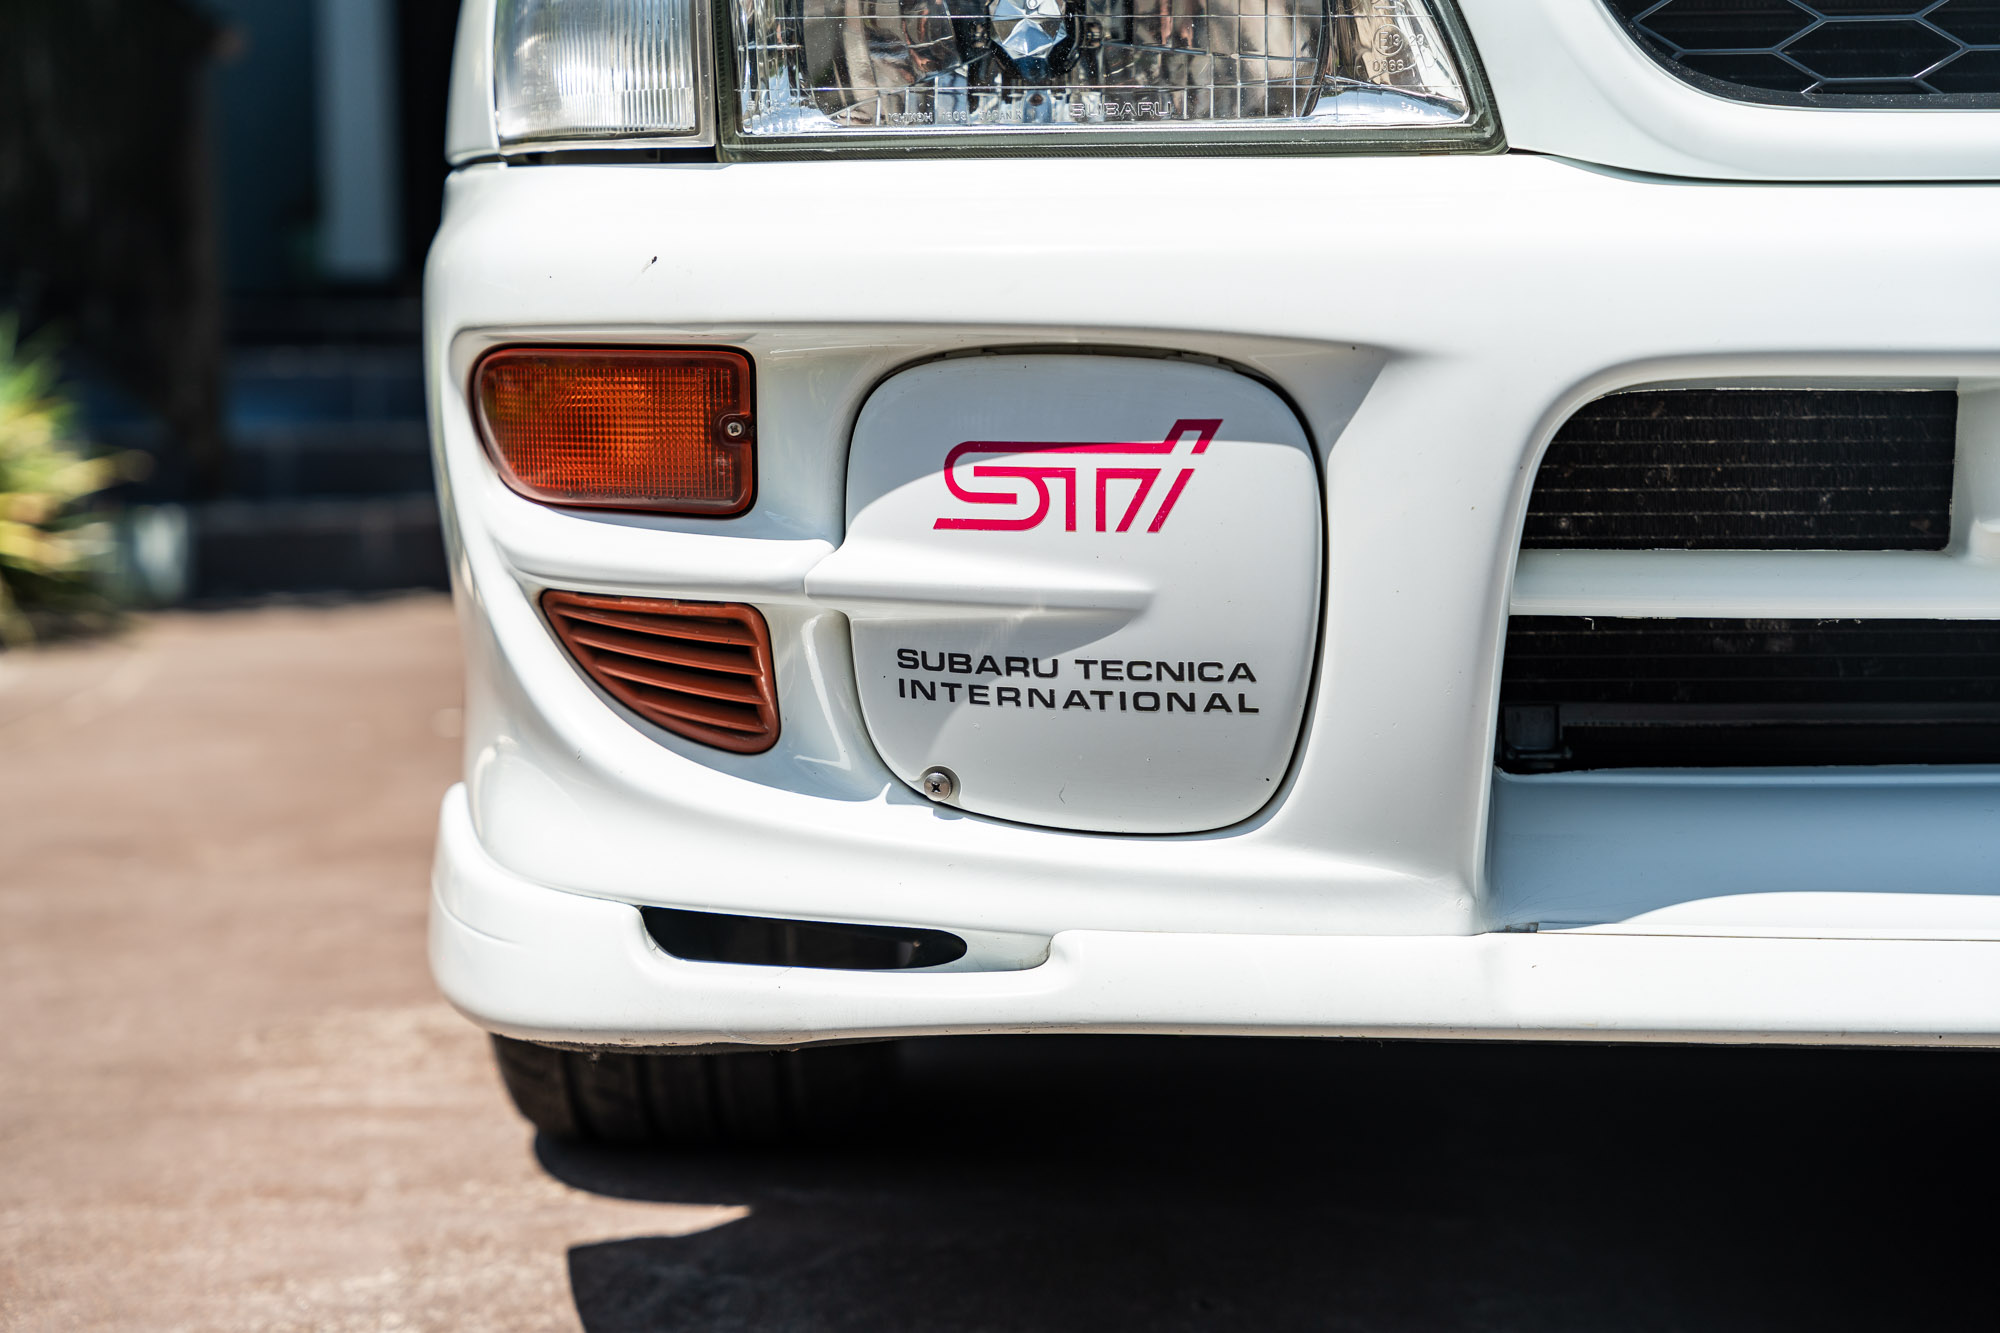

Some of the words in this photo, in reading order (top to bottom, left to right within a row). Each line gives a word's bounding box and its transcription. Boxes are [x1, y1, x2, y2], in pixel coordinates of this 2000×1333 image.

[1069, 101, 1173, 118] SUBARU
[896, 648, 1060, 680] SUBARU
[1074, 659, 1257, 683] TECNICA
[898, 678, 1261, 714] INTERNATIONAL
